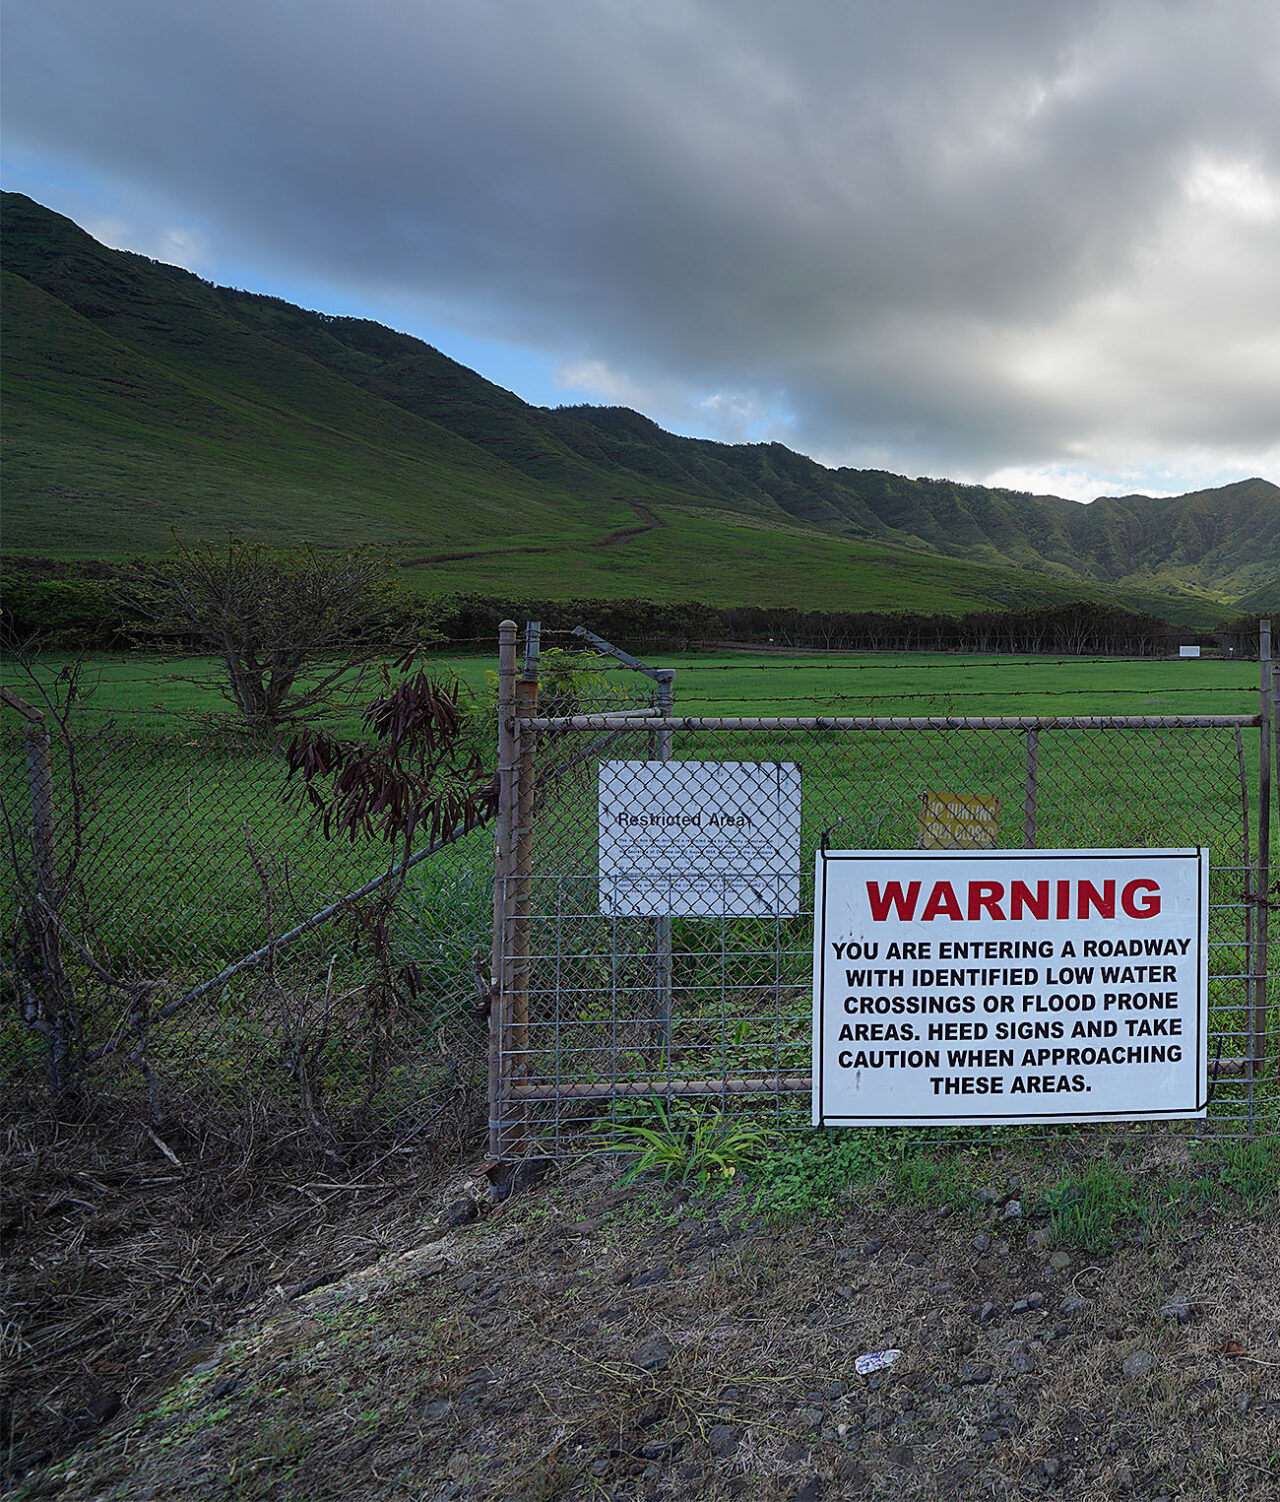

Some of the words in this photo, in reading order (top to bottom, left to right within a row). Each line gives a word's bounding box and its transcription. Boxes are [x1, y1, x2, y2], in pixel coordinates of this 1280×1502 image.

[618, 812, 701, 826] Restricted
[709, 812, 745, 826] Area
[866, 878, 1162, 922] WARNING
[831, 942, 878, 960] YOU
[886, 941, 931, 960] ARE
[939, 940, 1054, 959] ENTERING
[1061, 941, 1076, 958] A
[1083, 938, 1192, 957] ROADWAY
[845, 969, 902, 987] WITH
[912, 968, 1038, 986] IDENTIFIED
[1047, 967, 1094, 985] LOW
[1101, 965, 1177, 983] WATER
[844, 996, 975, 1014] CROSSINGS
[983, 995, 1015, 1013] OR
[1023, 994, 1096, 1012] FLOOD
[1103, 992, 1179, 1010] PRONE
[838, 1023, 920, 1041] AREAS.
[928, 1022, 988, 1041] HEED
[995, 1021, 1064, 1040] SIGNS
[1071, 1020, 1118, 1038] AND
[1125, 1018, 1183, 1037] TAKE
[838, 1050, 940, 1068] CAUTION
[947, 1049, 1014, 1067] WHEN
[1022, 1045, 1183, 1067] APPROACHING
[930, 1077, 1004, 1095] THESE
[1011, 1074, 1092, 1094] AREAS.
